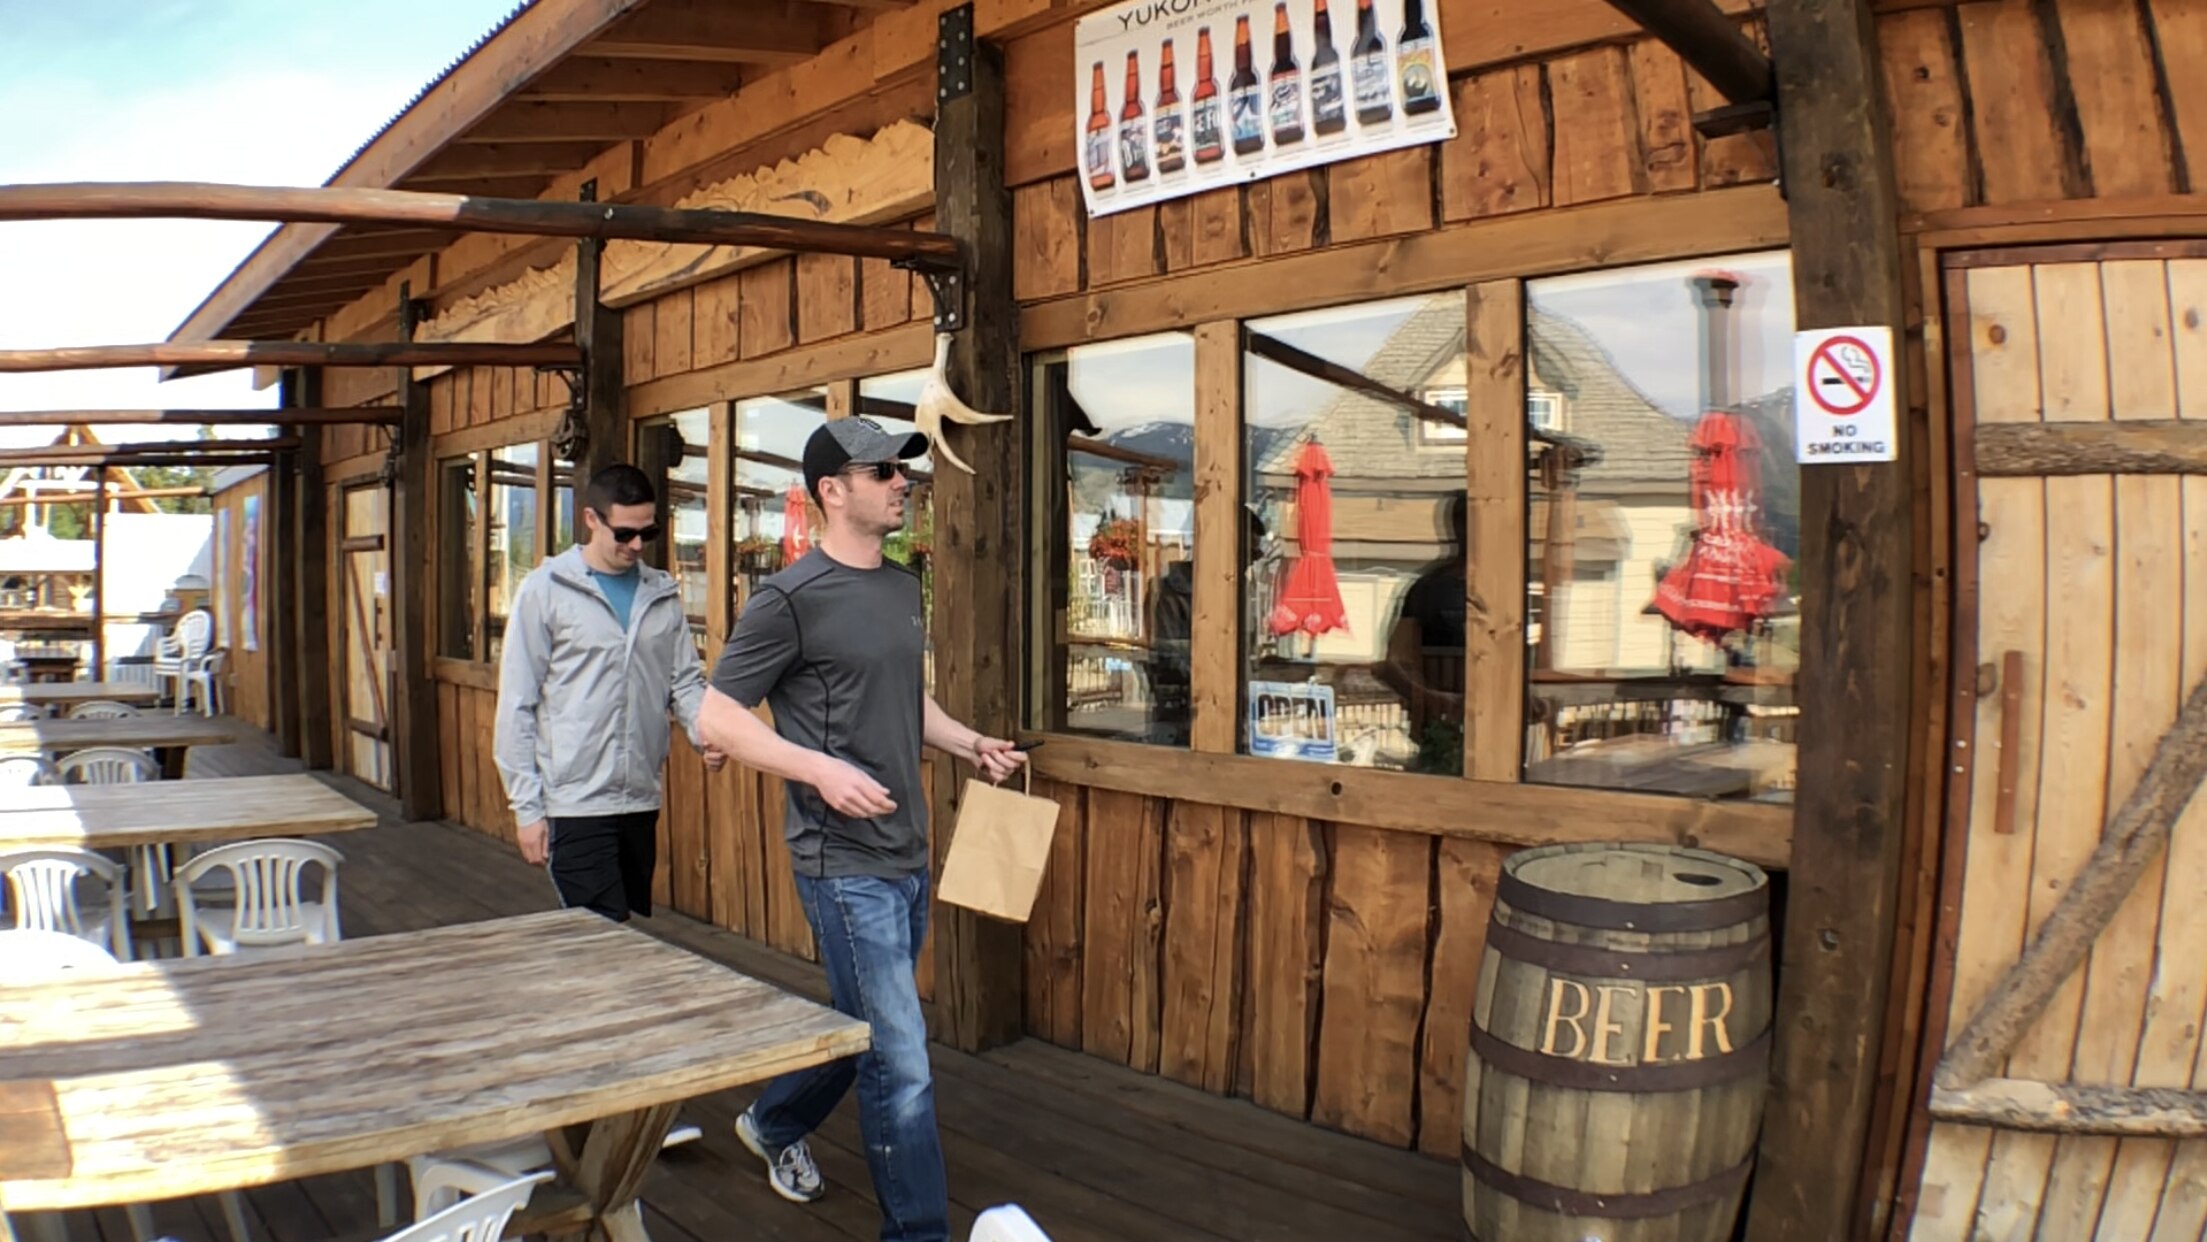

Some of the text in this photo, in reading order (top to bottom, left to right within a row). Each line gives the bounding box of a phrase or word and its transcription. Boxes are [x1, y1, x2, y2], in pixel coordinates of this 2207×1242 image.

[1166, 16, 1194, 30] BEER
[1197, 2, 1238, 19] WORTH
[1833, 425, 1857, 437] NO
[1808, 441, 1885, 455] SMOKING
[1257, 694, 1328, 741] OPEN
[1539, 977, 1734, 1067] BEER
